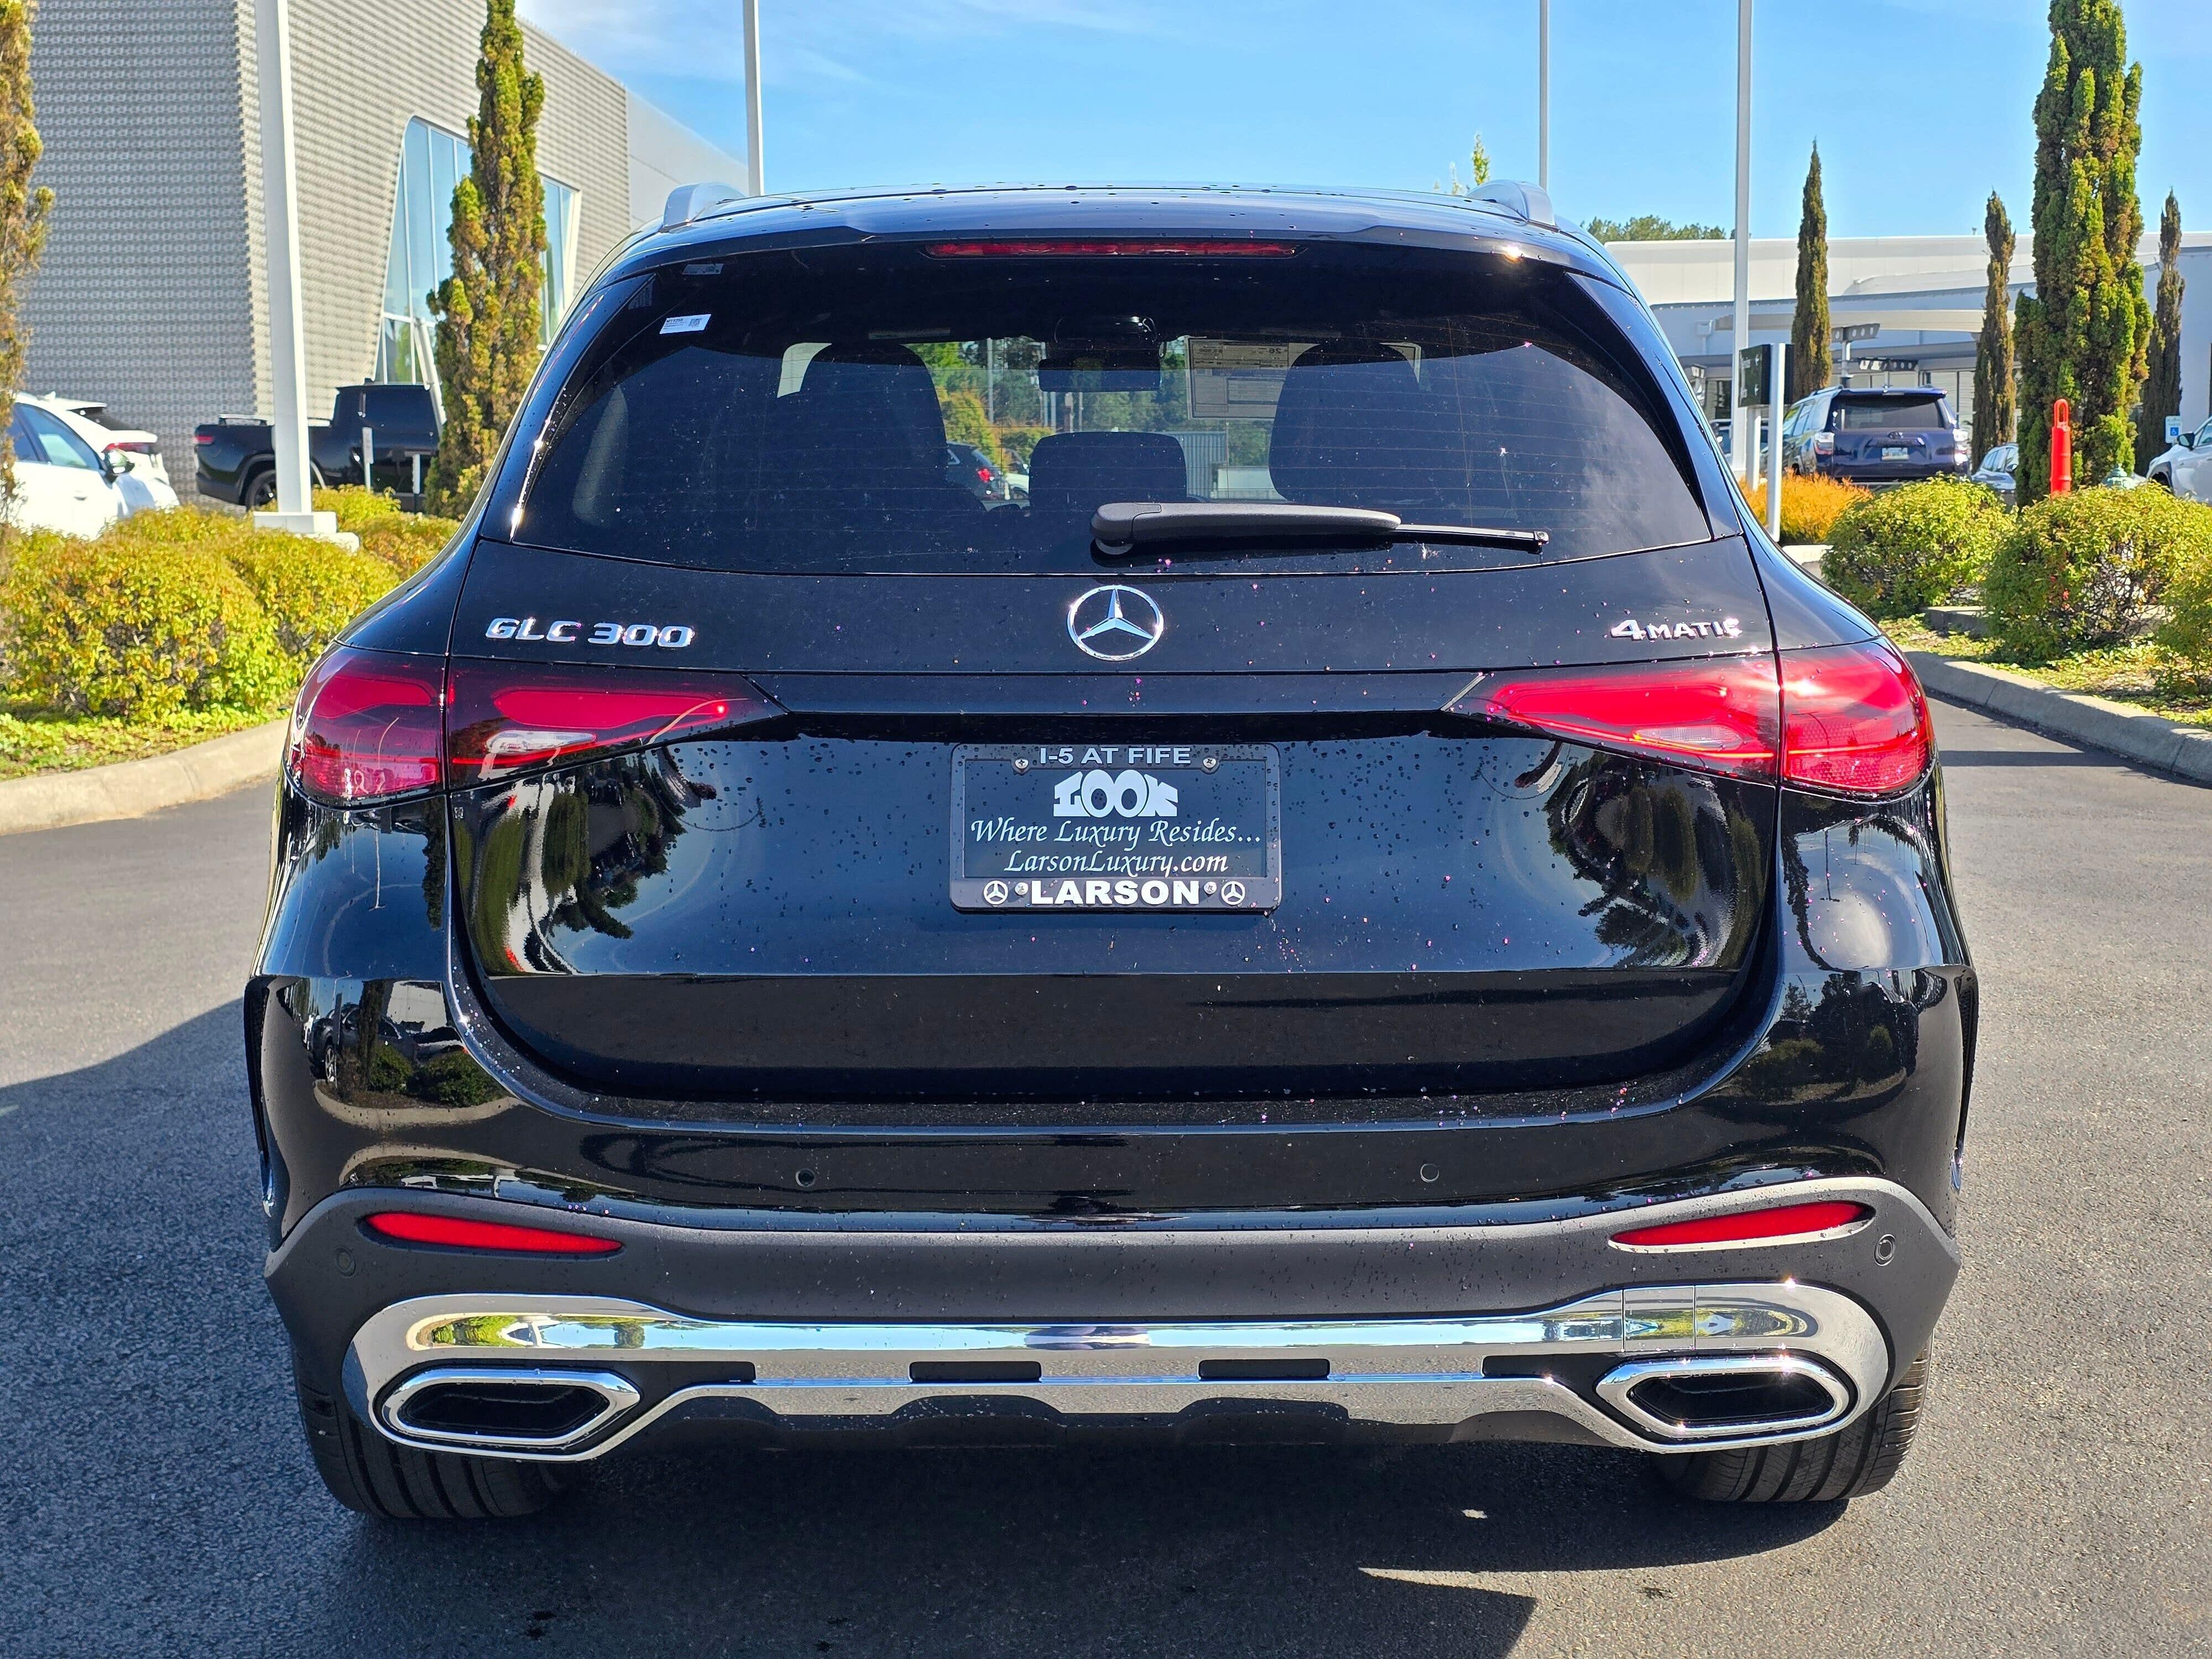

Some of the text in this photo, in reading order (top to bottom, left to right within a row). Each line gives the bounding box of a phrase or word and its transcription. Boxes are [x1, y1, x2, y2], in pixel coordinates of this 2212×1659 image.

[486, 617, 695, 648] GLC 300
[1611, 618, 1743, 641] 4MATIC
[1040, 748, 1191, 764] I-5 AT FIFE
[971, 817, 1261, 851] Where Luxury Resides...
[1004, 850, 1228, 878] LarsonLuxury.com
[1031, 880, 1199, 905] LARSON
